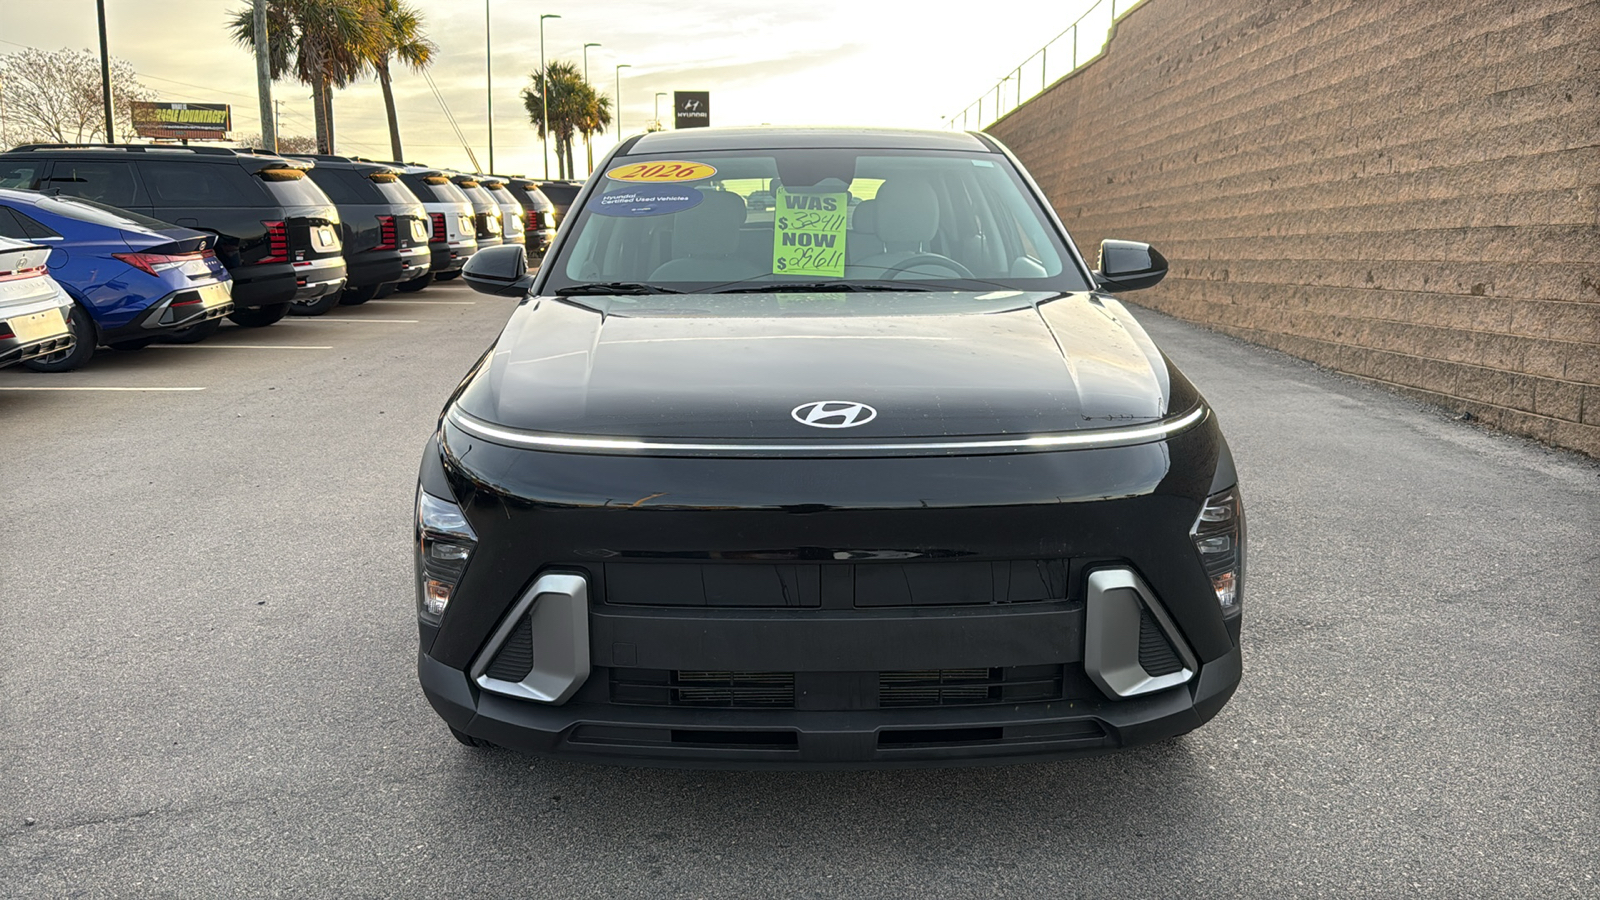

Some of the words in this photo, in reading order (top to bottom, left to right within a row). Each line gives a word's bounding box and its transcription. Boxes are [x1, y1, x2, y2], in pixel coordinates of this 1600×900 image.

[179, 109, 226, 124] ADVANTAGE?
[621, 164, 701, 179] 2026
[603, 193, 635, 201] Hyundai
[785, 195, 837, 212] WAS
[782, 232, 837, 248] NOW
[789, 247, 843, 270] 29611
